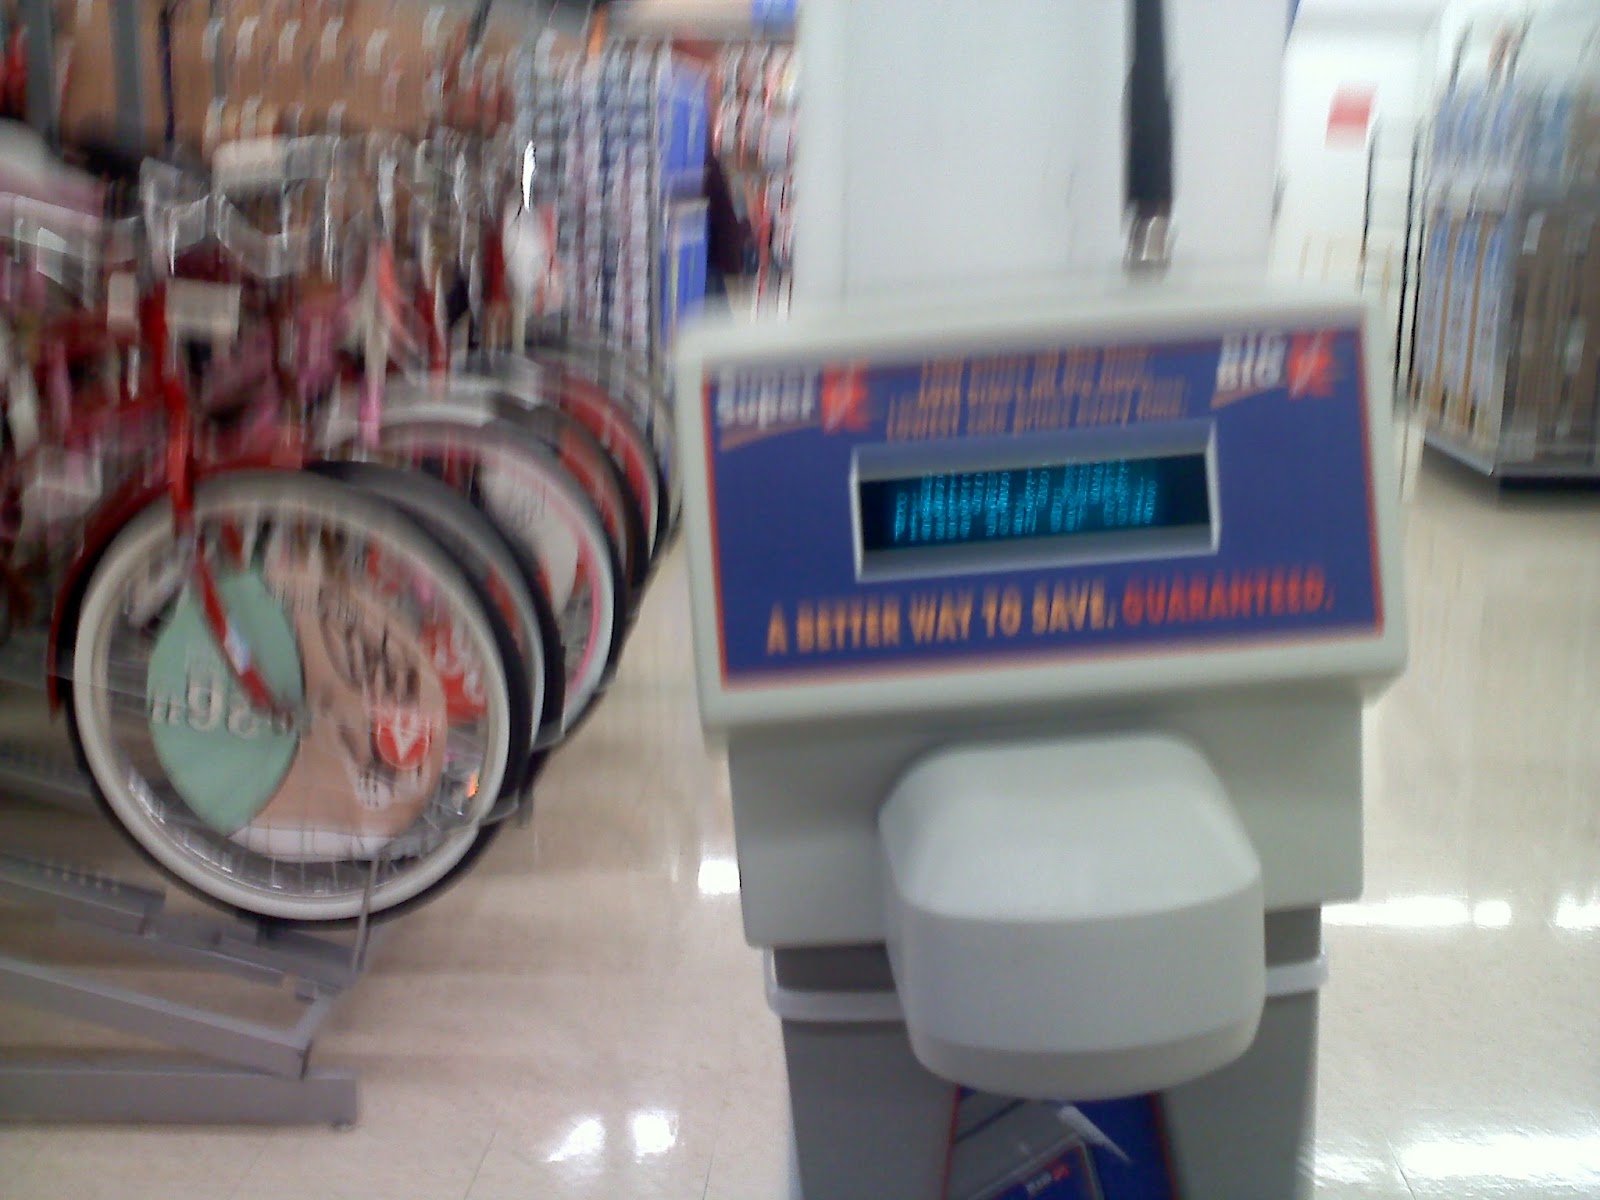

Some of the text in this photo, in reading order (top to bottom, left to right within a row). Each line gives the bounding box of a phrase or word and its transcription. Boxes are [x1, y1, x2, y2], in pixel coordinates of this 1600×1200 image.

[766, 601, 788, 655] A
[796, 594, 900, 653] BETTER
[908, 586, 973, 645] WAY
[982, 583, 1022, 638] TO
